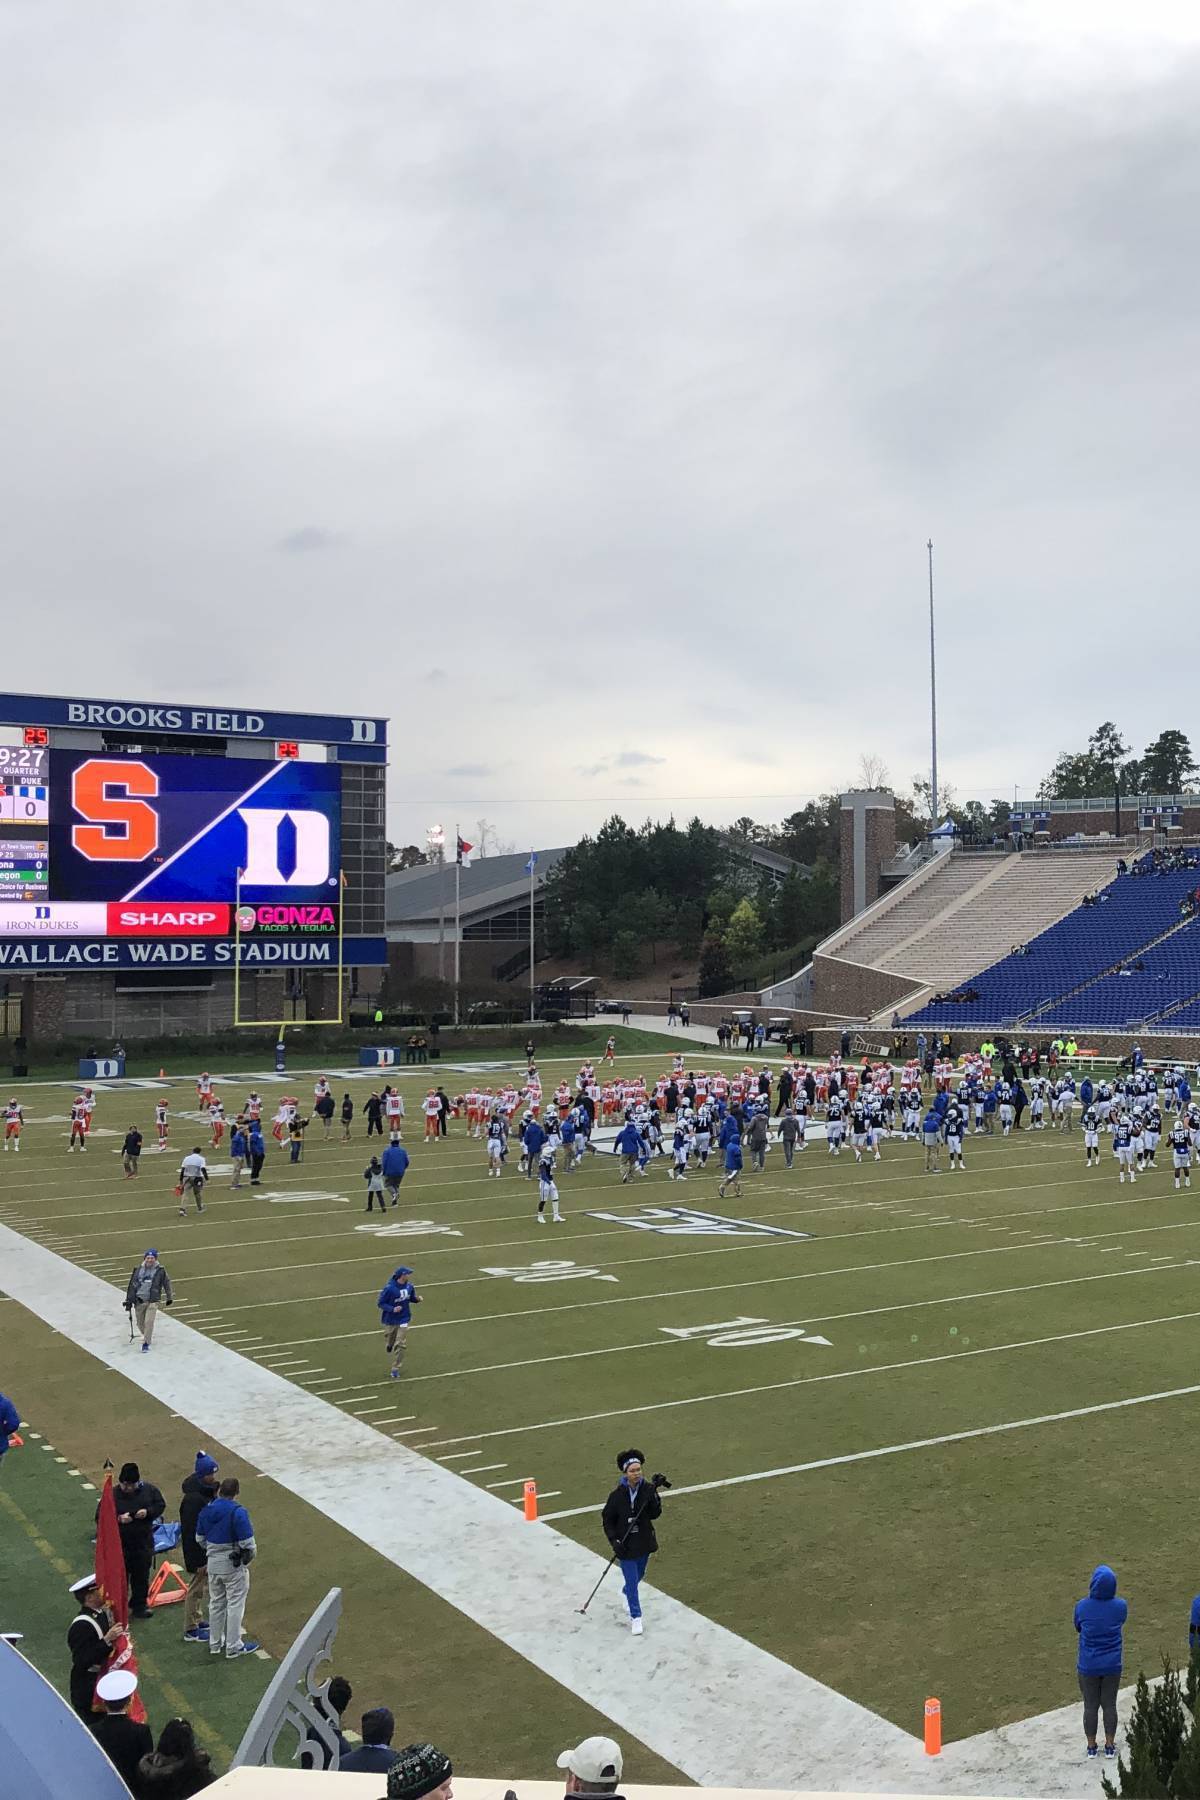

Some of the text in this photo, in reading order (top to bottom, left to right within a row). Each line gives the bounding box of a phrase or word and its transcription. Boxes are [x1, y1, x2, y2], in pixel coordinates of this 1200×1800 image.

[68, 703, 264, 733] BROOKS FIELD
[25, 727, 47, 744] 25
[350, 719, 377, 742] D
[3, 766, 40, 775] QUARTER
[20, 777, 42, 785] DUKE
[25, 801, 36, 817] 0
[72, 758, 160, 862] S
[237, 807, 331, 886] D
[120, 911, 217, 926] SHARP
[257, 906, 335, 925] GONZA
[6, 920, 79, 930] IRON DUKES
[259, 924, 336, 932] TACOS Y TEQUILA
[128, 943, 206, 962] WADE
[214, 942, 331, 962] STADIUM
[698, 1117, 708, 1127] 71
[1174, 1133, 1185, 1143] 92
[478, 1260, 602, 1283] 20
[657, 1316, 807, 1348] 10
